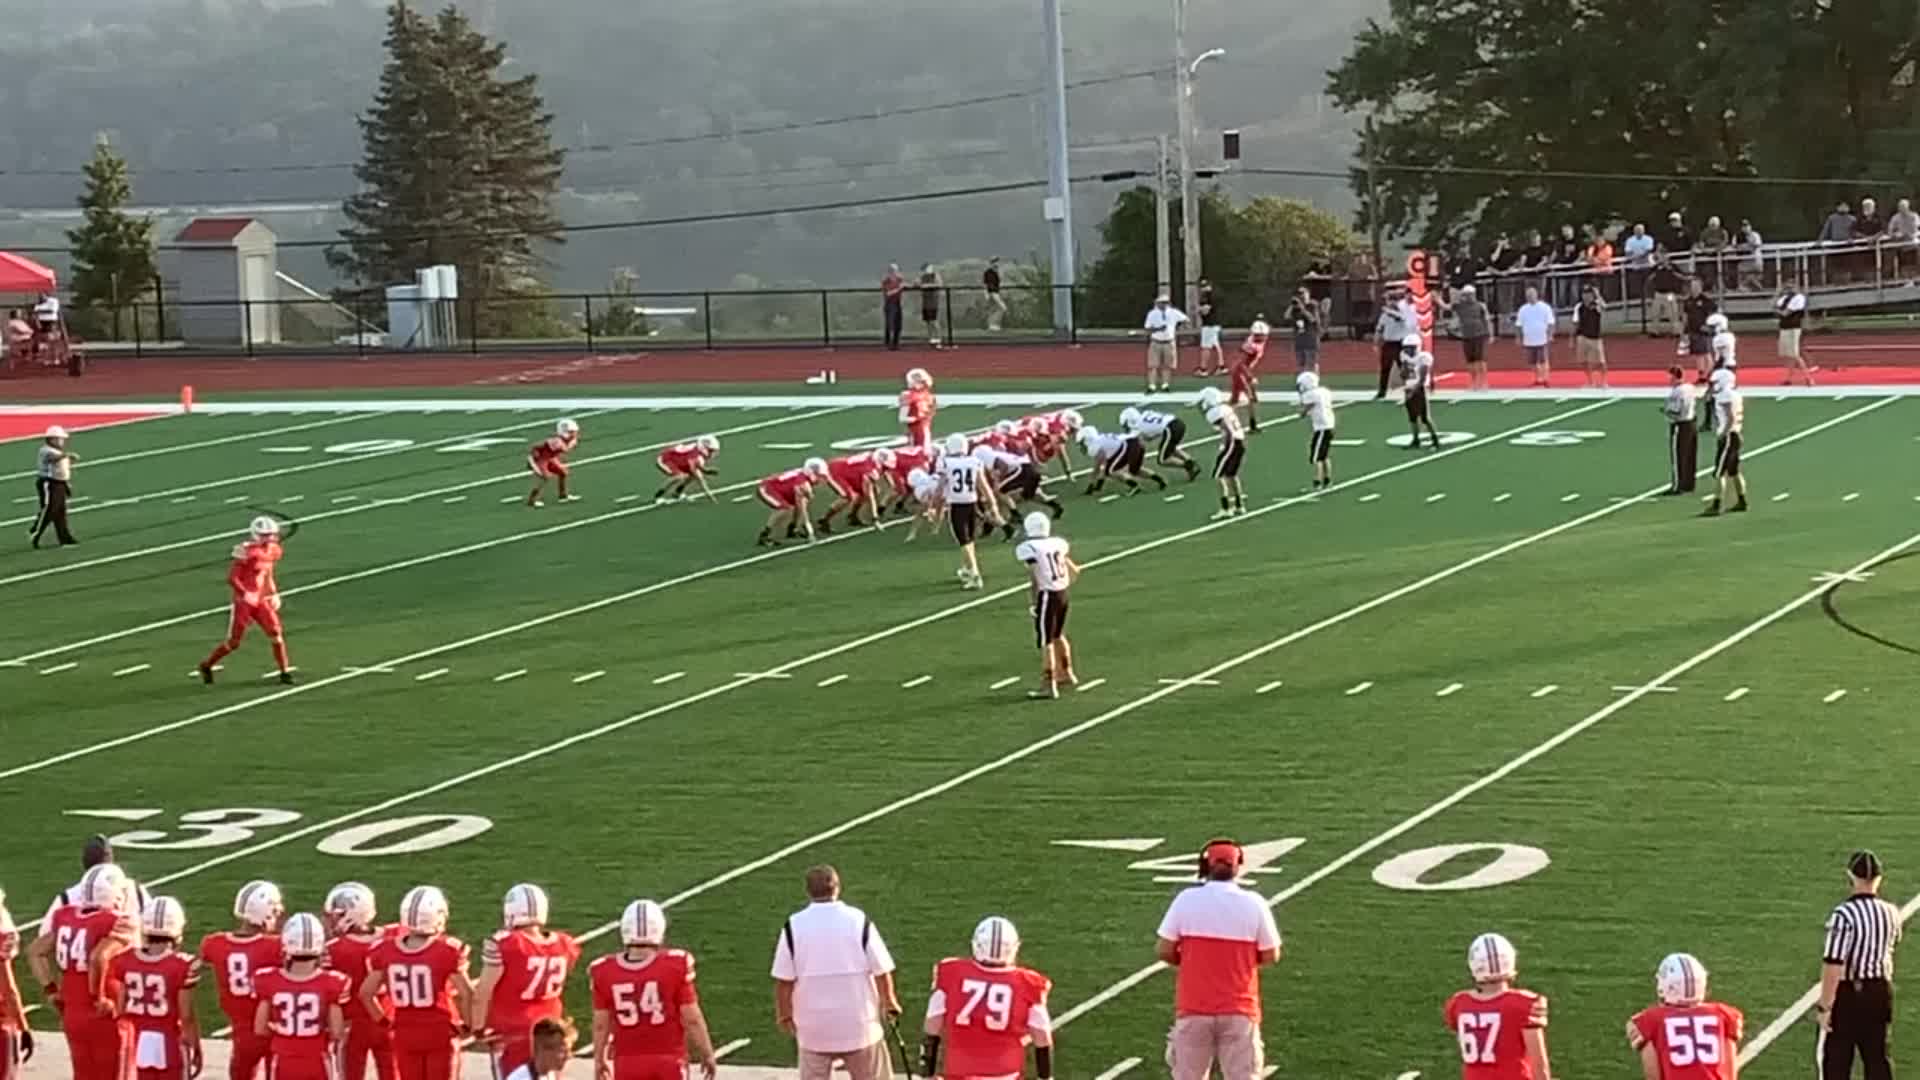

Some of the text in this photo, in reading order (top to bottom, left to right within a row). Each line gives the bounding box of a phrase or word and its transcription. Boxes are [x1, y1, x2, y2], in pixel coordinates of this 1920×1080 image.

[952, 468, 973, 493] 34
[56, 926, 87, 972] 64
[124, 971, 169, 1018] 23
[387, 964, 433, 1008] 60
[521, 956, 566, 1000] 72
[271, 992, 320, 1037] 32
[612, 981, 665, 1026] 54
[955, 980, 1013, 1031] 79
[1457, 1012, 1501, 1064] 67
[1663, 1014, 1720, 1066] 55
